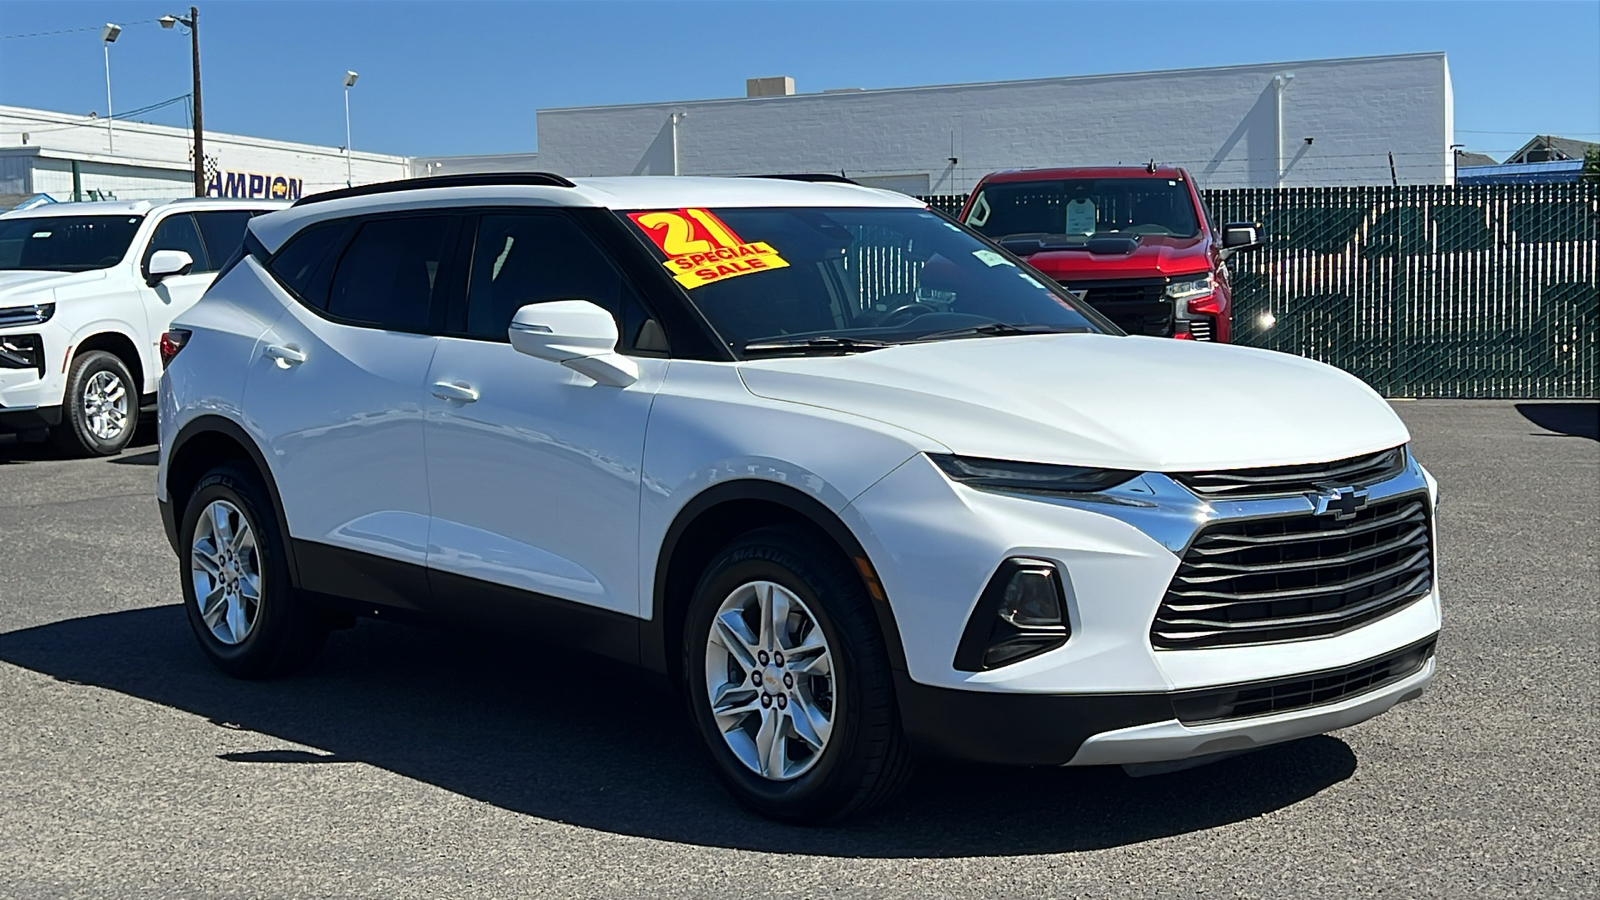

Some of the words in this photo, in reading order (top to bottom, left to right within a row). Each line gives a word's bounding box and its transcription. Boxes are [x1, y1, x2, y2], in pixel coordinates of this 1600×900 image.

[638, 208, 742, 256] 21
[675, 245, 768, 270] SPECIAL
[695, 258, 767, 281] SALE
